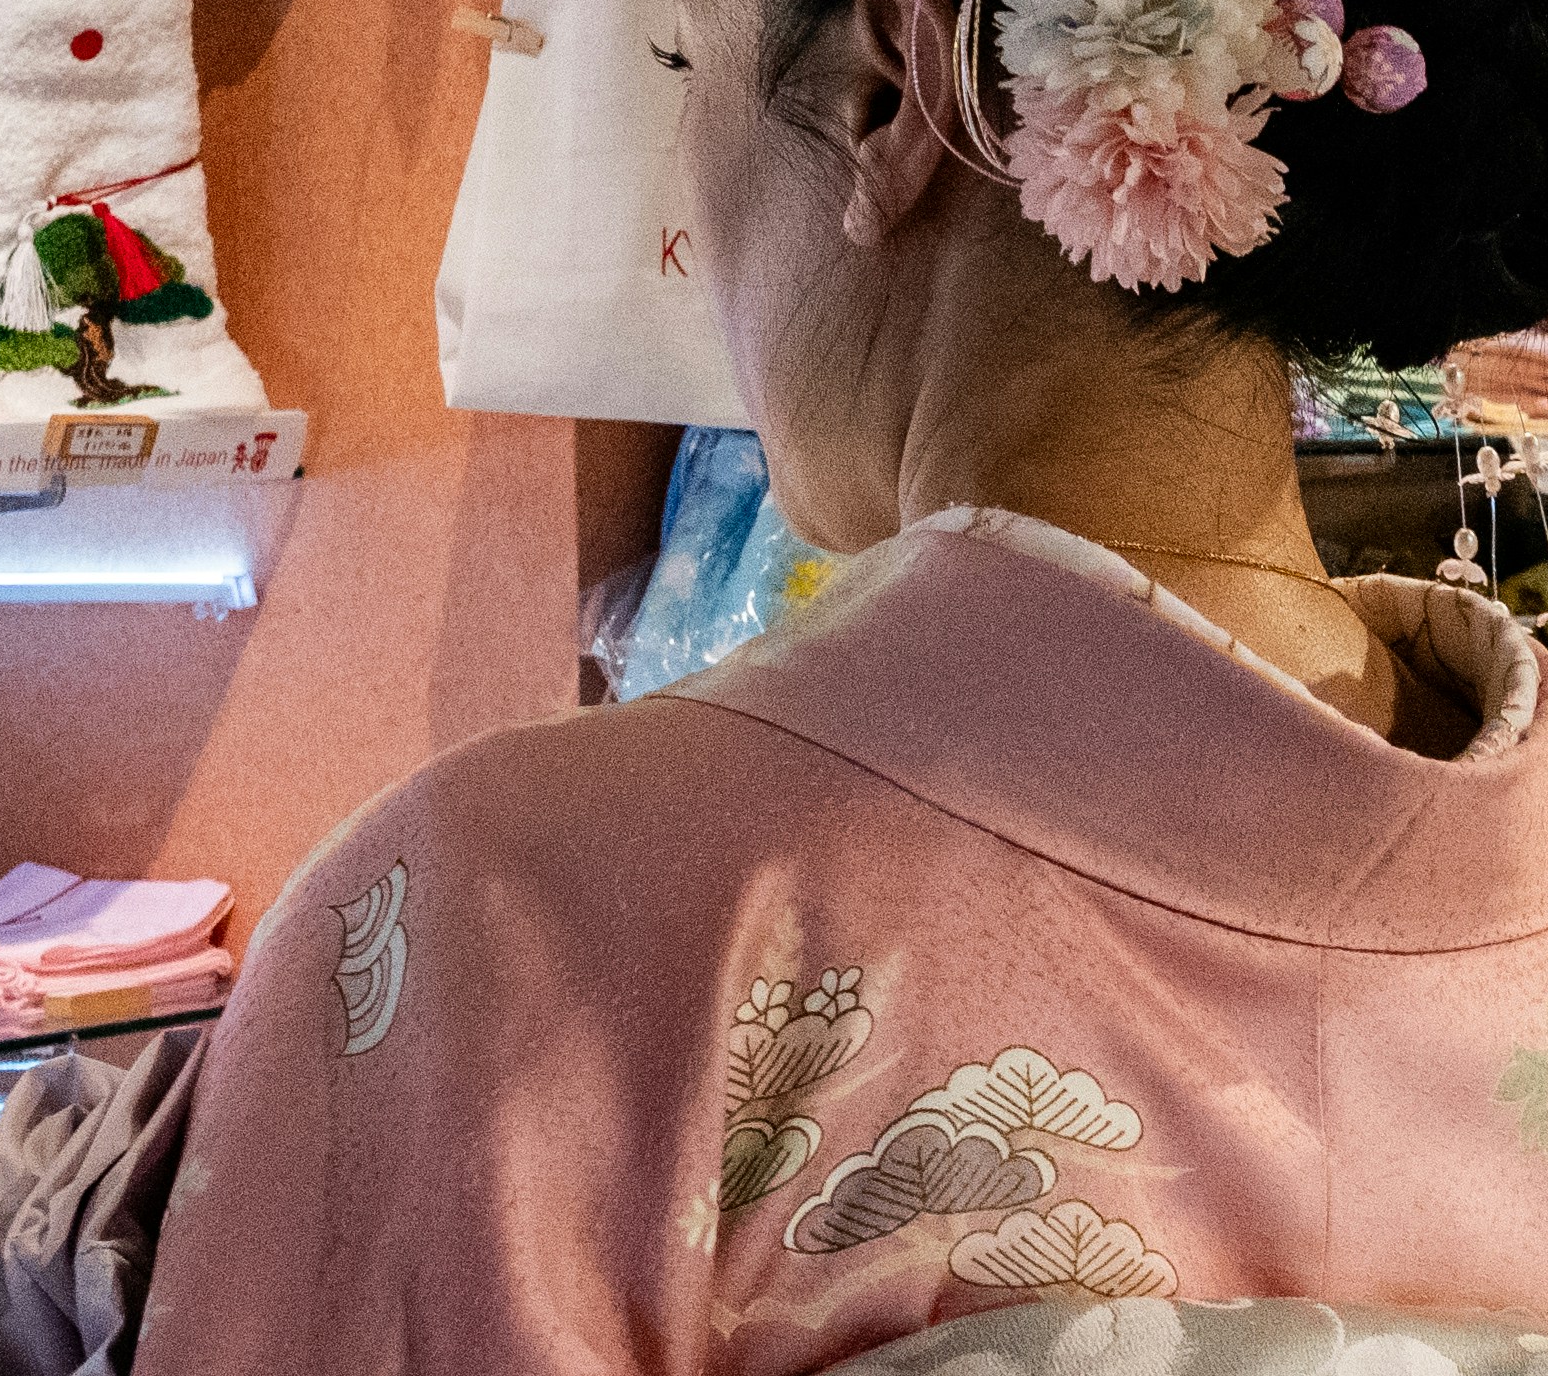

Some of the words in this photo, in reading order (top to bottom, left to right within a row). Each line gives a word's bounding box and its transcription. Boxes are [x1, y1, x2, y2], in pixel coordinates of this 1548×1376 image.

[8, 450, 38, 473] the
[155, 447, 172, 466] in
[175, 446, 228, 469] Japan
